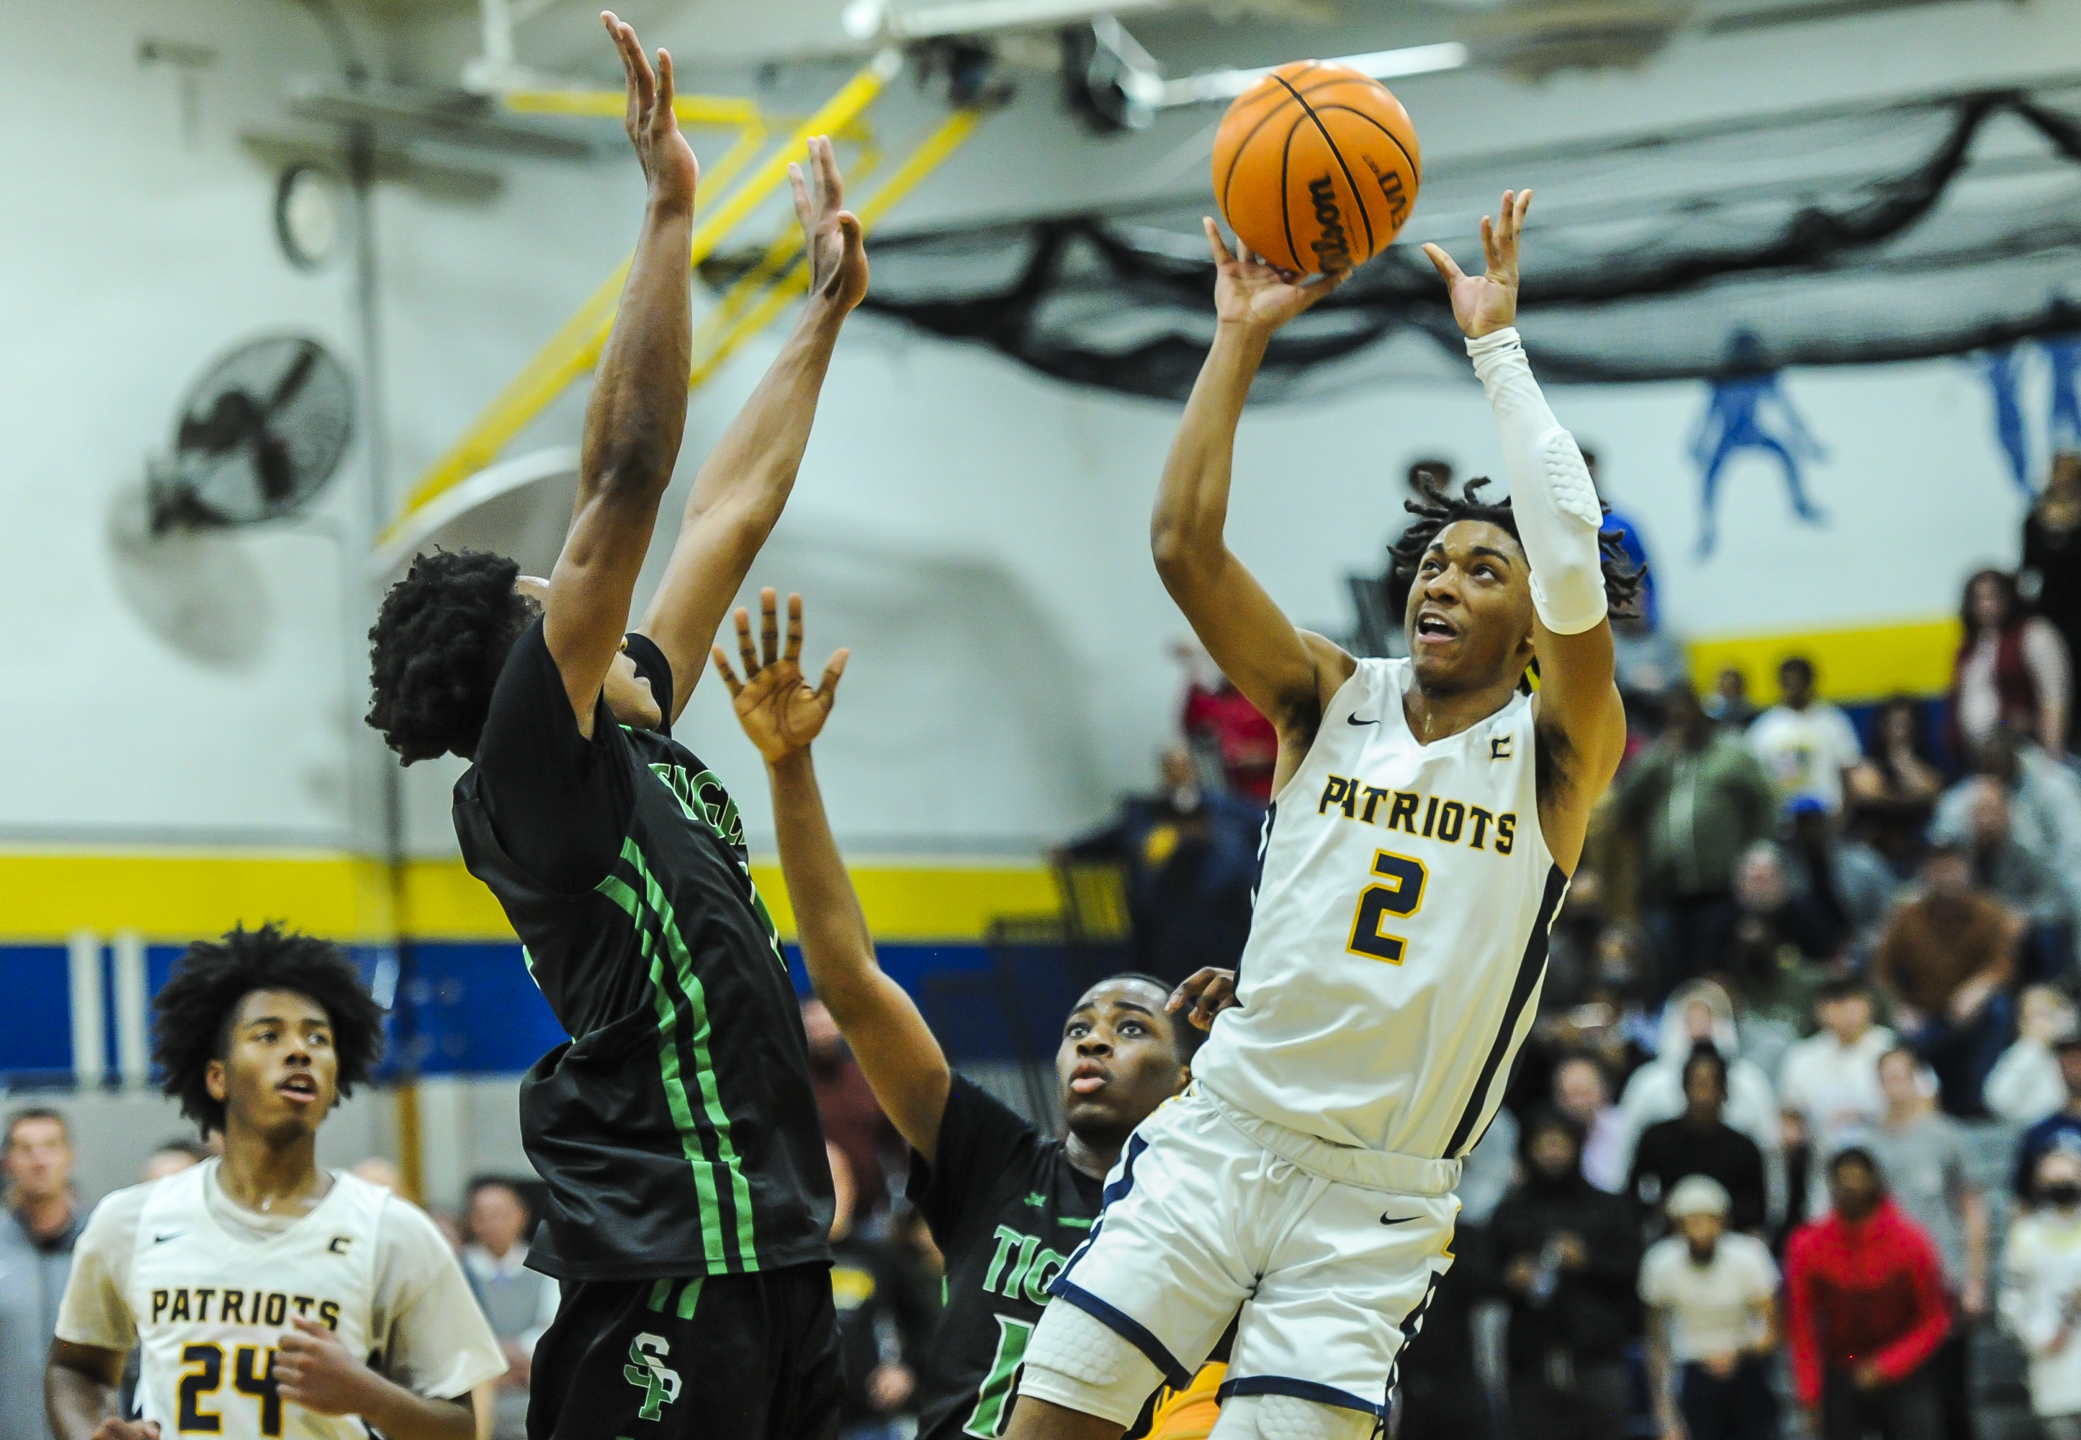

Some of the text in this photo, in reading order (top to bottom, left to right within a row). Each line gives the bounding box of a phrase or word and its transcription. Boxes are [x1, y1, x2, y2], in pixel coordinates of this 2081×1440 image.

[1317, 774, 1517, 856] PATRIOTS
[1345, 848, 1429, 966] 2
[983, 1224, 1068, 1306] TIG
[151, 1287, 342, 1332] PATRIOTS
[176, 1341, 284, 1438] 24
